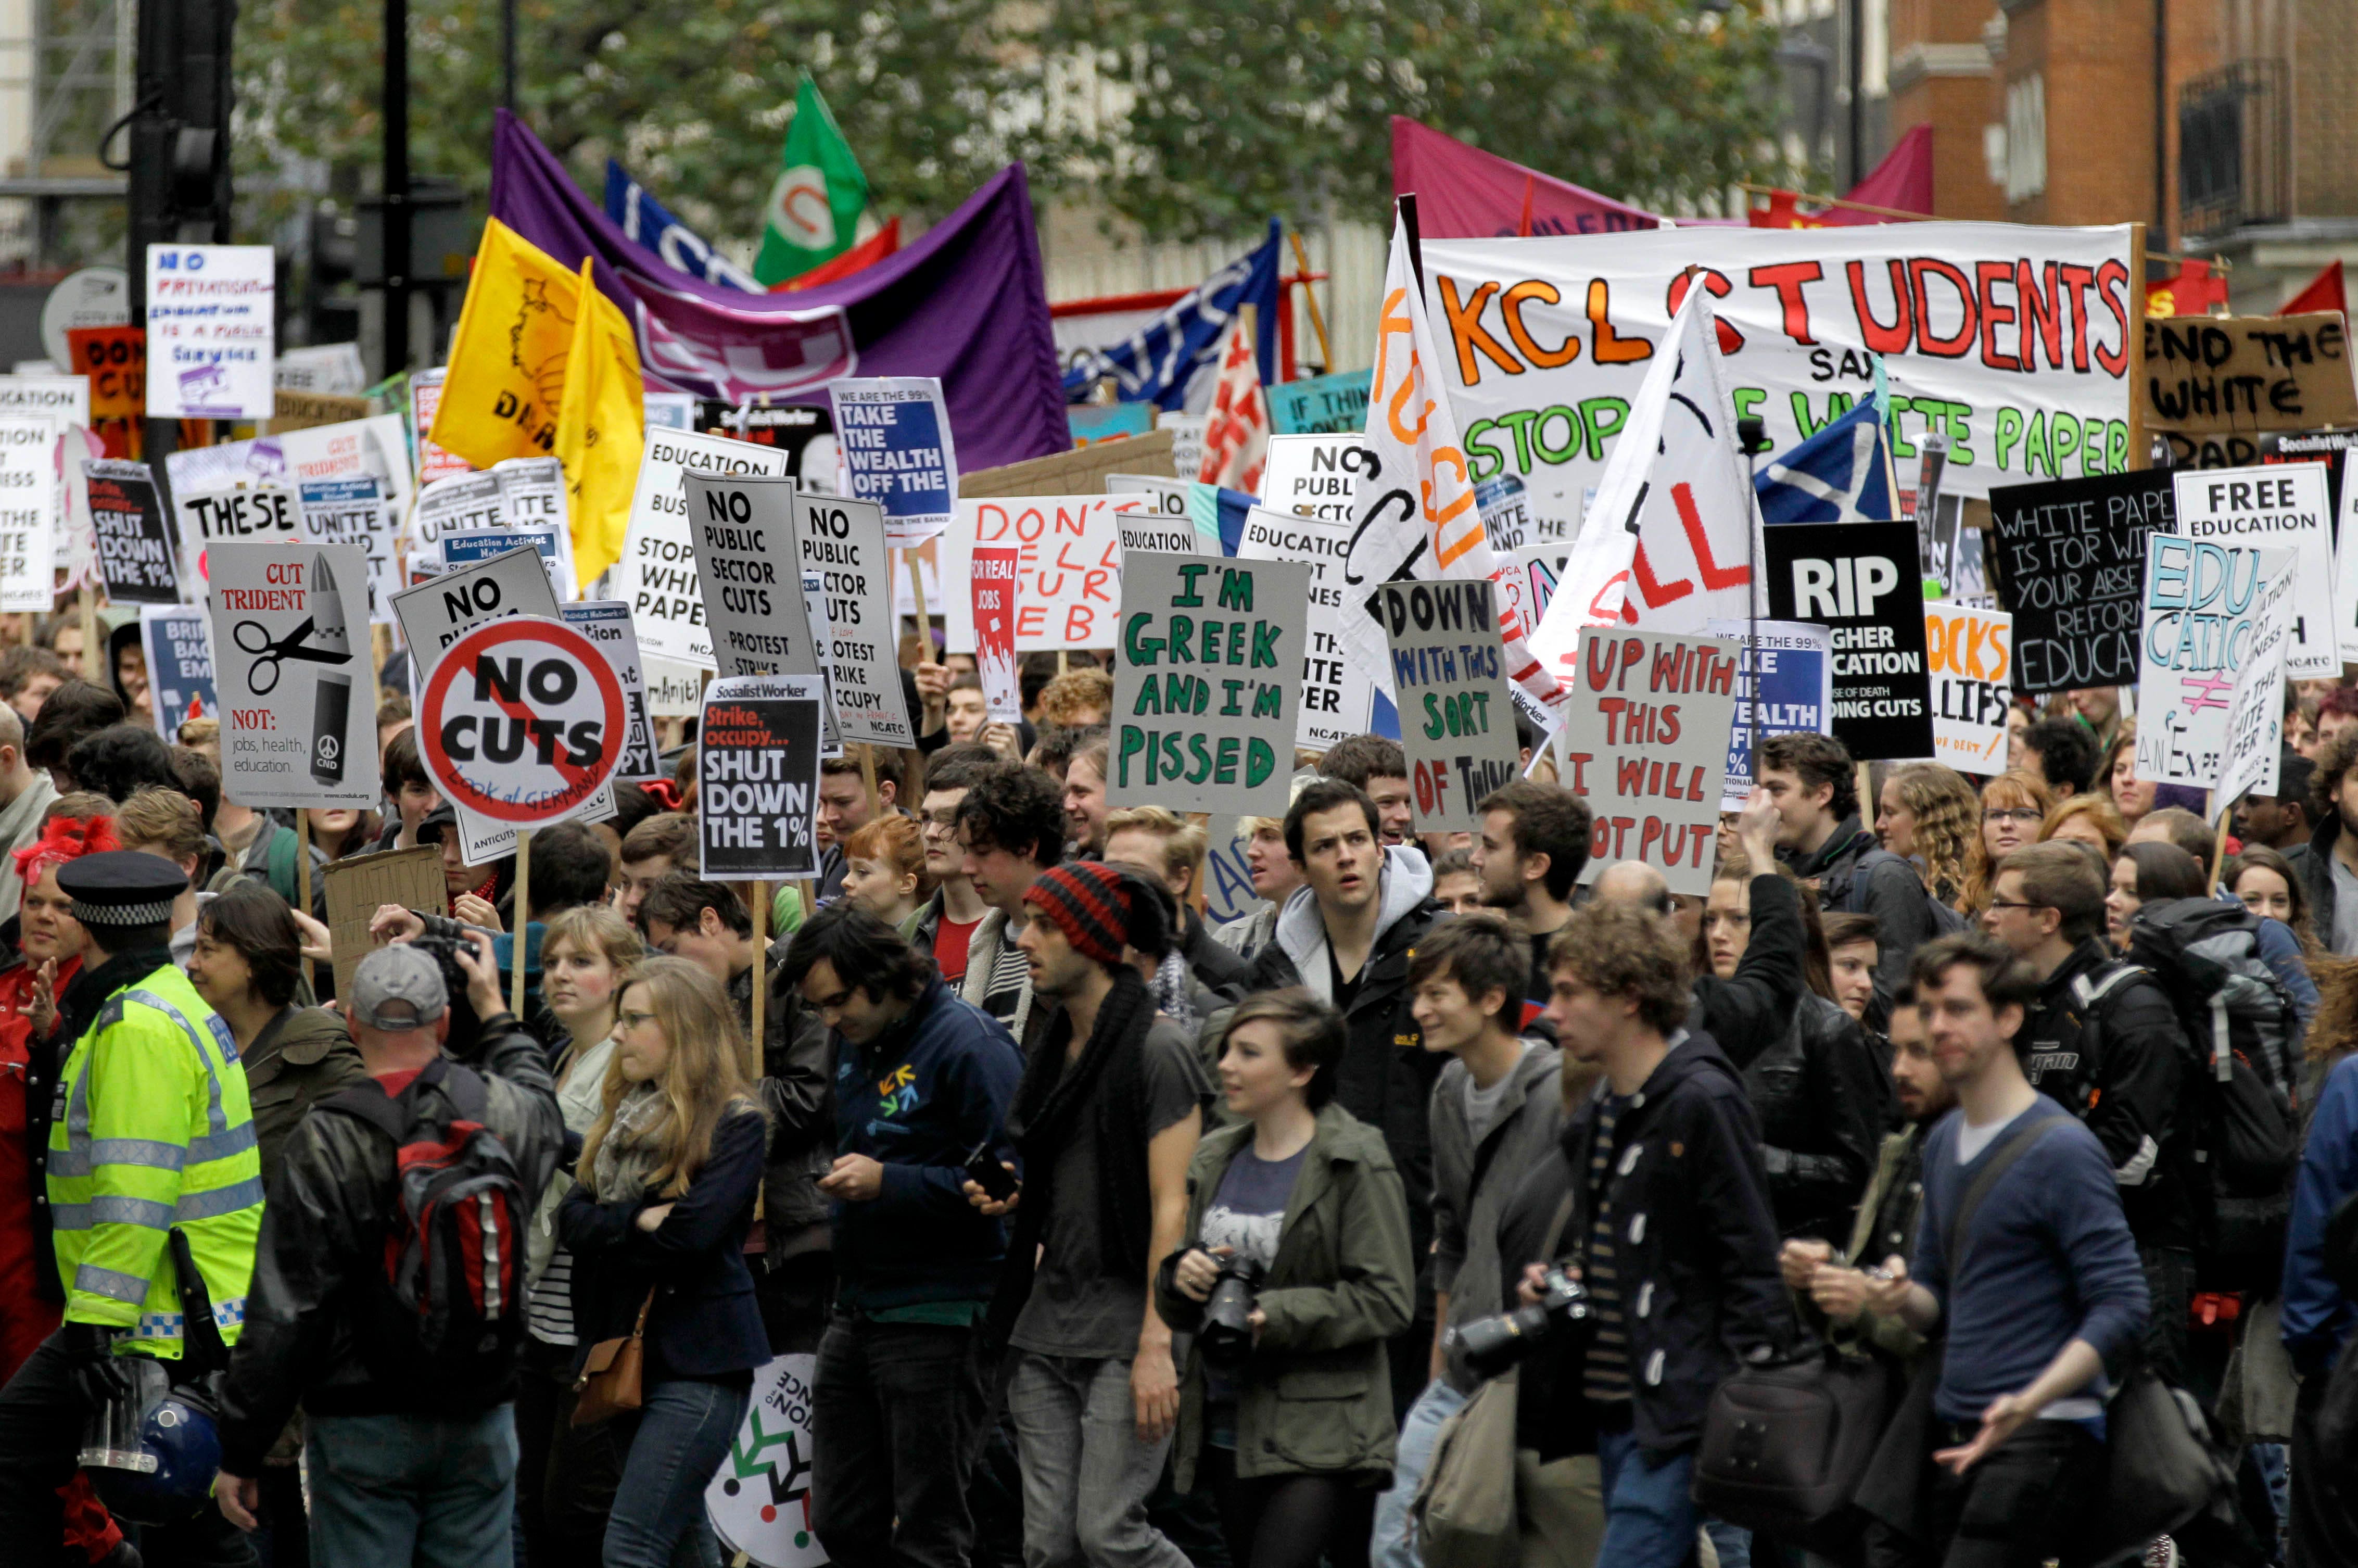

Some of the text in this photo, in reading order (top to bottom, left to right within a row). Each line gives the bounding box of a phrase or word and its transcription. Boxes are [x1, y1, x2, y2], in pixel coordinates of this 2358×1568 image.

[159, 252, 204, 270] NO
[1437, 275, 1653, 387] KCL
[1666, 258, 2129, 378] STUDENTS
[2145, 322, 2343, 369] END THE
[0, 390, 75, 404] CATION
[838, 389, 932, 402] WE ARE THE 99%
[2150, 373, 2303, 420] WHITE
[841, 405, 897, 426] TAKE
[1289, 396, 1308, 422] IF
[844, 429, 886, 448] THE
[1465, 397, 1630, 484] STOP
[1995, 407, 2128, 479] PAPER
[652, 444, 770, 475] EDUCATION
[848, 448, 941, 471] WEALTH
[1311, 446, 1363, 472] NO
[854, 471, 946, 493] OFF THE
[1293, 477, 1355, 496] PUBL
[513, 495, 557, 516] ITE
[706, 490, 751, 524] NO
[2208, 479, 2296, 513] FREE
[2, 510, 40, 527] THE
[94, 511, 143, 537] SHUT
[185, 494, 295, 538] THESE
[305, 510, 382, 535] UNITE
[422, 507, 505, 543] UNITE
[809, 507, 850, 540] NO
[1993, 489, 2175, 538] WHITE PAPE
[2190, 513, 2317, 537] EDUCATION
[704, 525, 766, 552] PUBLIC
[1492, 529, 1525, 551] AND
[1537, 517, 1566, 537] HE
[99, 537, 164, 563] DOWN
[452, 536, 547, 550] Education Activist
[638, 536, 694, 564] STOP
[803, 540, 860, 566] PUBLIC
[1122, 530, 1191, 551] EDUCATION
[1248, 524, 1348, 558] EDUCATIO
[1020, 540, 1119, 573] ELL
[2011, 534, 2101, 576] IS FOR
[105, 562, 174, 588] THE 1%
[266, 563, 305, 585] CUT
[641, 563, 697, 596] WHI
[711, 557, 777, 584] SECTOR
[971, 559, 1013, 580] FOR REAL
[820, 572, 867, 596] CTOR
[1171, 563, 1253, 612] I'M
[1792, 555, 1898, 618] RIP
[2015, 563, 2140, 609] YOUR ARSE
[221, 589, 306, 611] TRIDENT
[443, 576, 501, 624] NO
[635, 591, 707, 627] PAPE
[722, 586, 771, 616] CUTS
[825, 597, 860, 625] UTS
[978, 590, 1001, 610] JOBS
[1386, 583, 1490, 638] DOWN
[166, 621, 205, 640] BRI
[1016, 604, 1121, 642] EB
[174, 641, 209, 659] BAC
[689, 642, 714, 655] NCA
[730, 630, 789, 656] PROTEST
[1125, 612, 1283, 669] GREEK
[1766, 636, 1791, 648] THE
[1795, 637, 1822, 649] 99%
[1830, 625, 1895, 650] GHER
[1926, 614, 2010, 682] OCKS
[2147, 611, 2253, 673] CATIO
[833, 640, 874, 662] OTEST
[1832, 651, 1920, 675] CATION
[2019, 628, 2143, 690] EDUCA
[180, 659, 211, 678] EM
[735, 657, 779, 676] STRIKE
[833, 664, 867, 685] RIKE
[1303, 657, 1343, 685] ITE
[1392, 646, 1456, 689] WITH
[1587, 636, 1736, 696] UP WITH
[473, 655, 578, 706] NO
[716, 685, 807, 698] Socialist Worker
[1846, 686, 1890, 698] OF DEATH
[836, 688, 881, 710] CCUPY
[1133, 672, 1282, 719] AND I'M
[1832, 699, 1922, 718] DING CUTS
[232, 709, 276, 730] NOT:
[705, 705, 764, 728] Strike,
[1423, 691, 1489, 741] SORT
[1599, 697, 1681, 746] THIS
[1734, 703, 1818, 727] EALTH
[233, 737, 306, 754] jobs, health,
[440, 715, 603, 768] CUTS
[705, 729, 789, 748] occupy...
[235, 758, 294, 773] education.
[316, 758, 337, 769] CND
[705, 750, 786, 781] SHUT
[1119, 725, 1275, 789] PISSED
[2136, 736, 2165, 774] AN
[1414, 758, 1449, 817] OF
[1569, 753, 1706, 802] I WILL
[706, 783, 807, 815] DOWN
[706, 815, 808, 848] THE 1%
[1591, 816, 1714, 868] OT PUT
